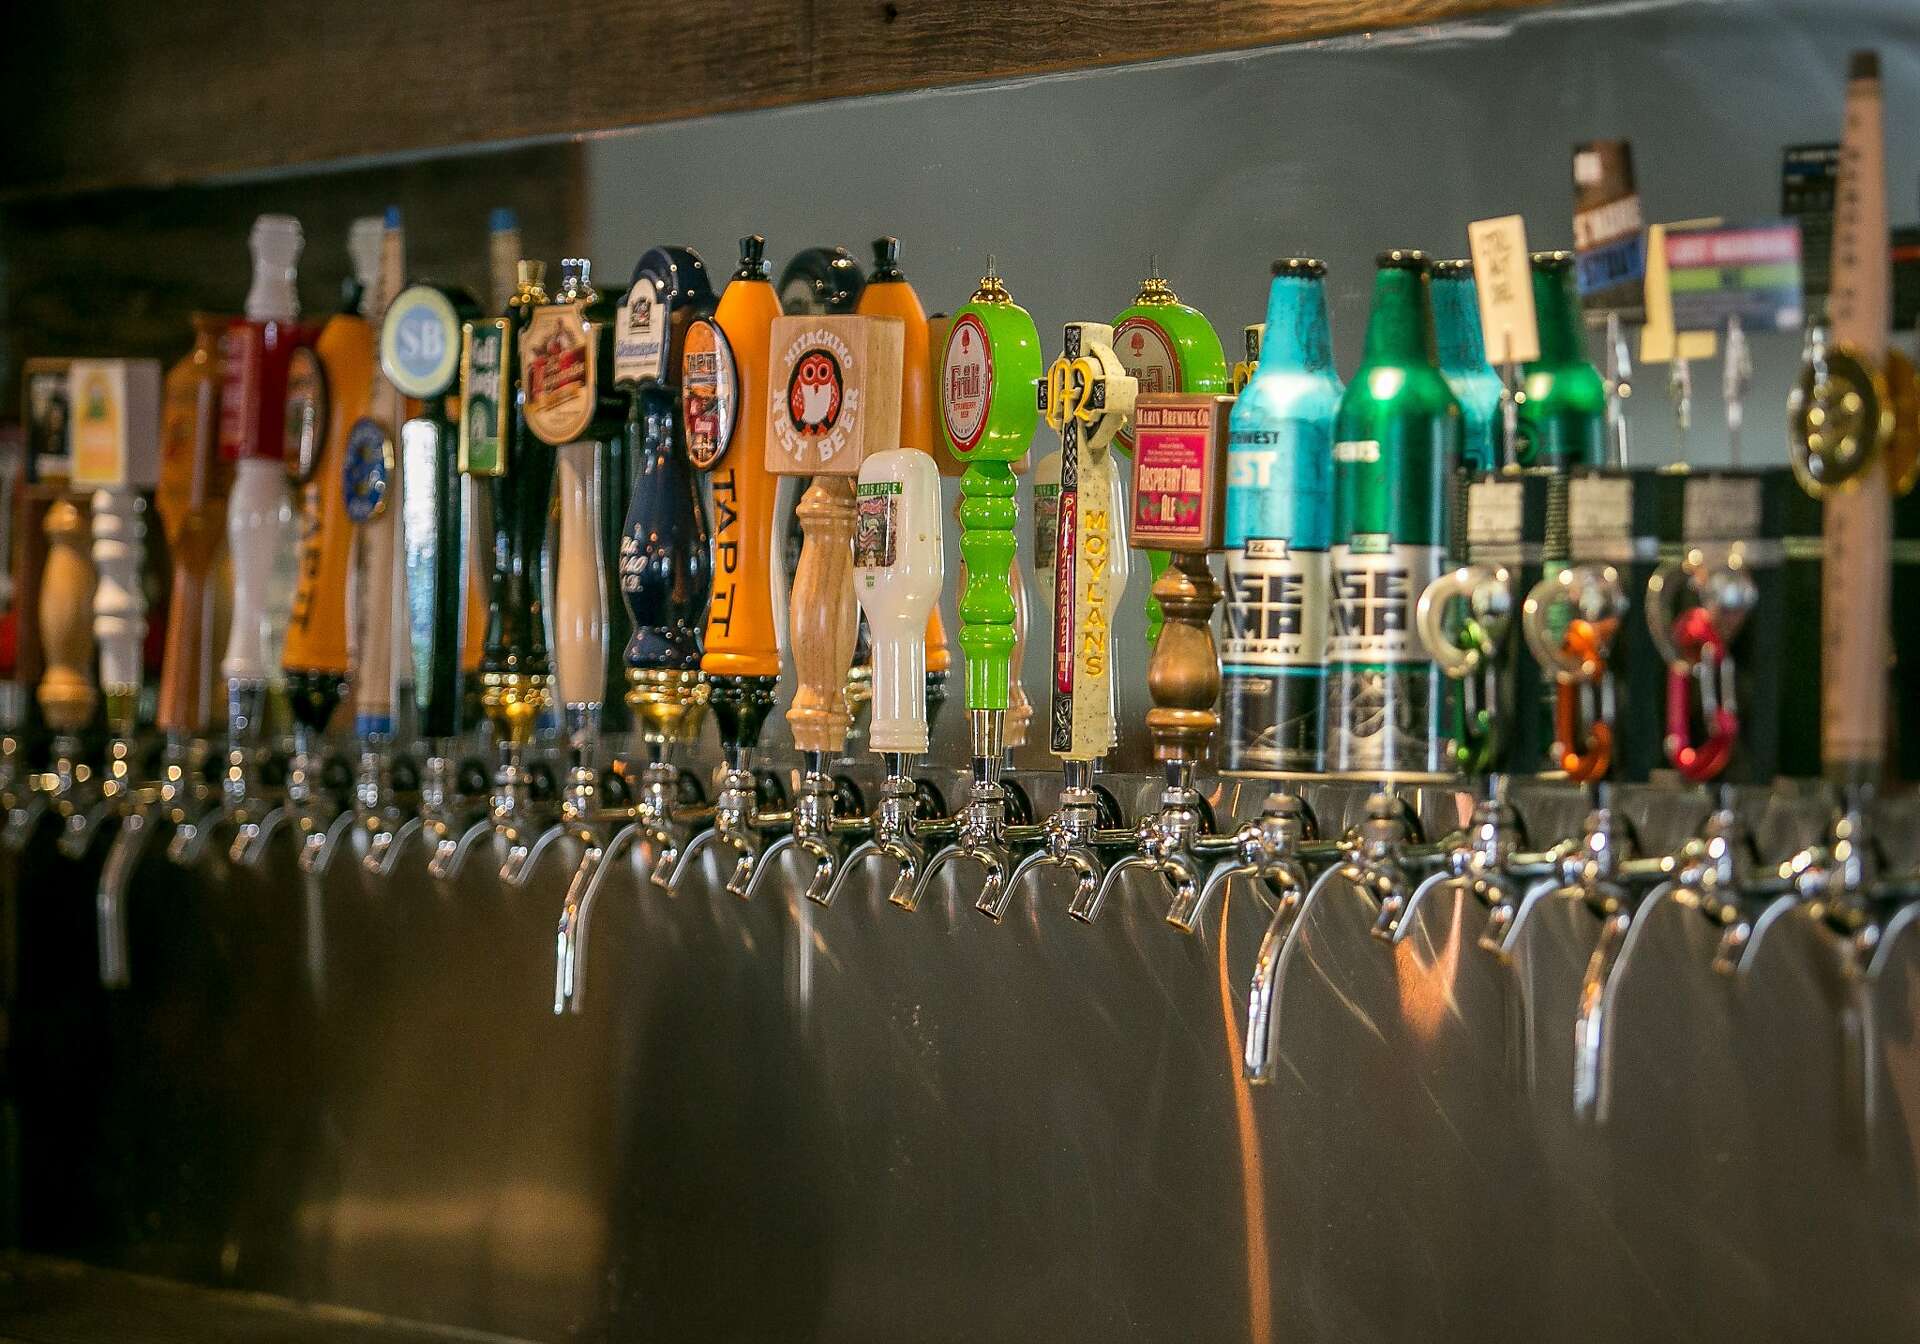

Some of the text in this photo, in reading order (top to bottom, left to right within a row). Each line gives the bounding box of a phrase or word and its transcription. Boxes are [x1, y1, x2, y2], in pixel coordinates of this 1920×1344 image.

[400, 319, 443, 357] SB
[784, 328, 853, 369] HITACHINO
[772, 388, 860, 462] NEST BEER
[1136, 408, 1161, 426] MARIN
[1161, 408, 1197, 426] BREWING
[1140, 464, 1181, 492] RASPBERRY
[1228, 451, 1278, 486] ST
[713, 469, 738, 574] TAP
[1161, 494, 1176, 521] ALE
[1084, 510, 1108, 677] MOYLANS
